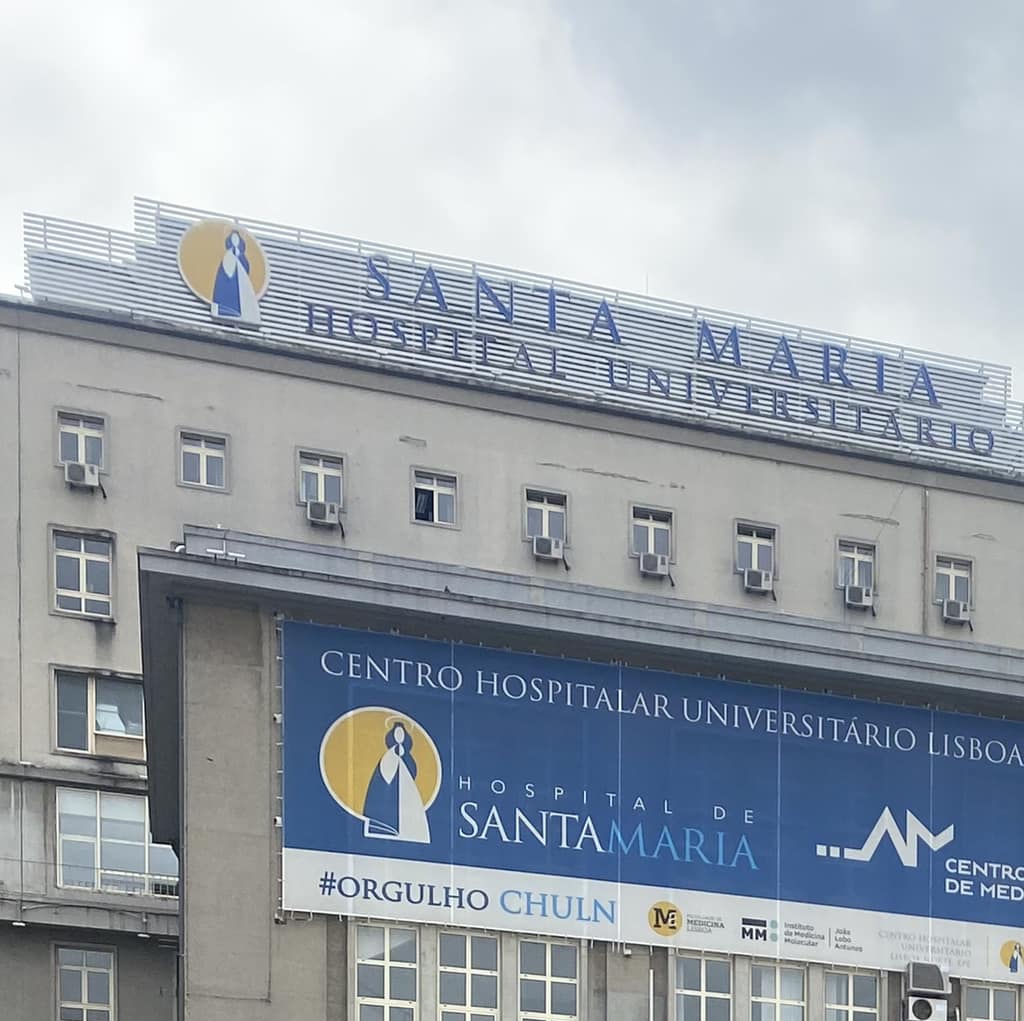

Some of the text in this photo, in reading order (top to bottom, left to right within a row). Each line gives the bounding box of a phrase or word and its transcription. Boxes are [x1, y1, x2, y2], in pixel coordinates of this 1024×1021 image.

[305, 302, 566, 378] HOSPITAL
[366, 254, 942, 407] SANTA MARIA
[320, 649, 463, 692] CENTRO
[476, 669, 675, 720] HOSPITALAR
[682, 697, 917, 753] UNIVERSITÁRIO
[928, 732, 1024, 768] LISBOA
[459, 774, 754, 825] HOSPITAL DE
[459, 801, 760, 871] SANTAMARIA
[319, 870, 617, 925] #ORGULHO CHULN
[945, 877, 974, 896] DE
[687, 918, 725, 929] MEDICINA
[794, 931, 826, 941] Medicina
